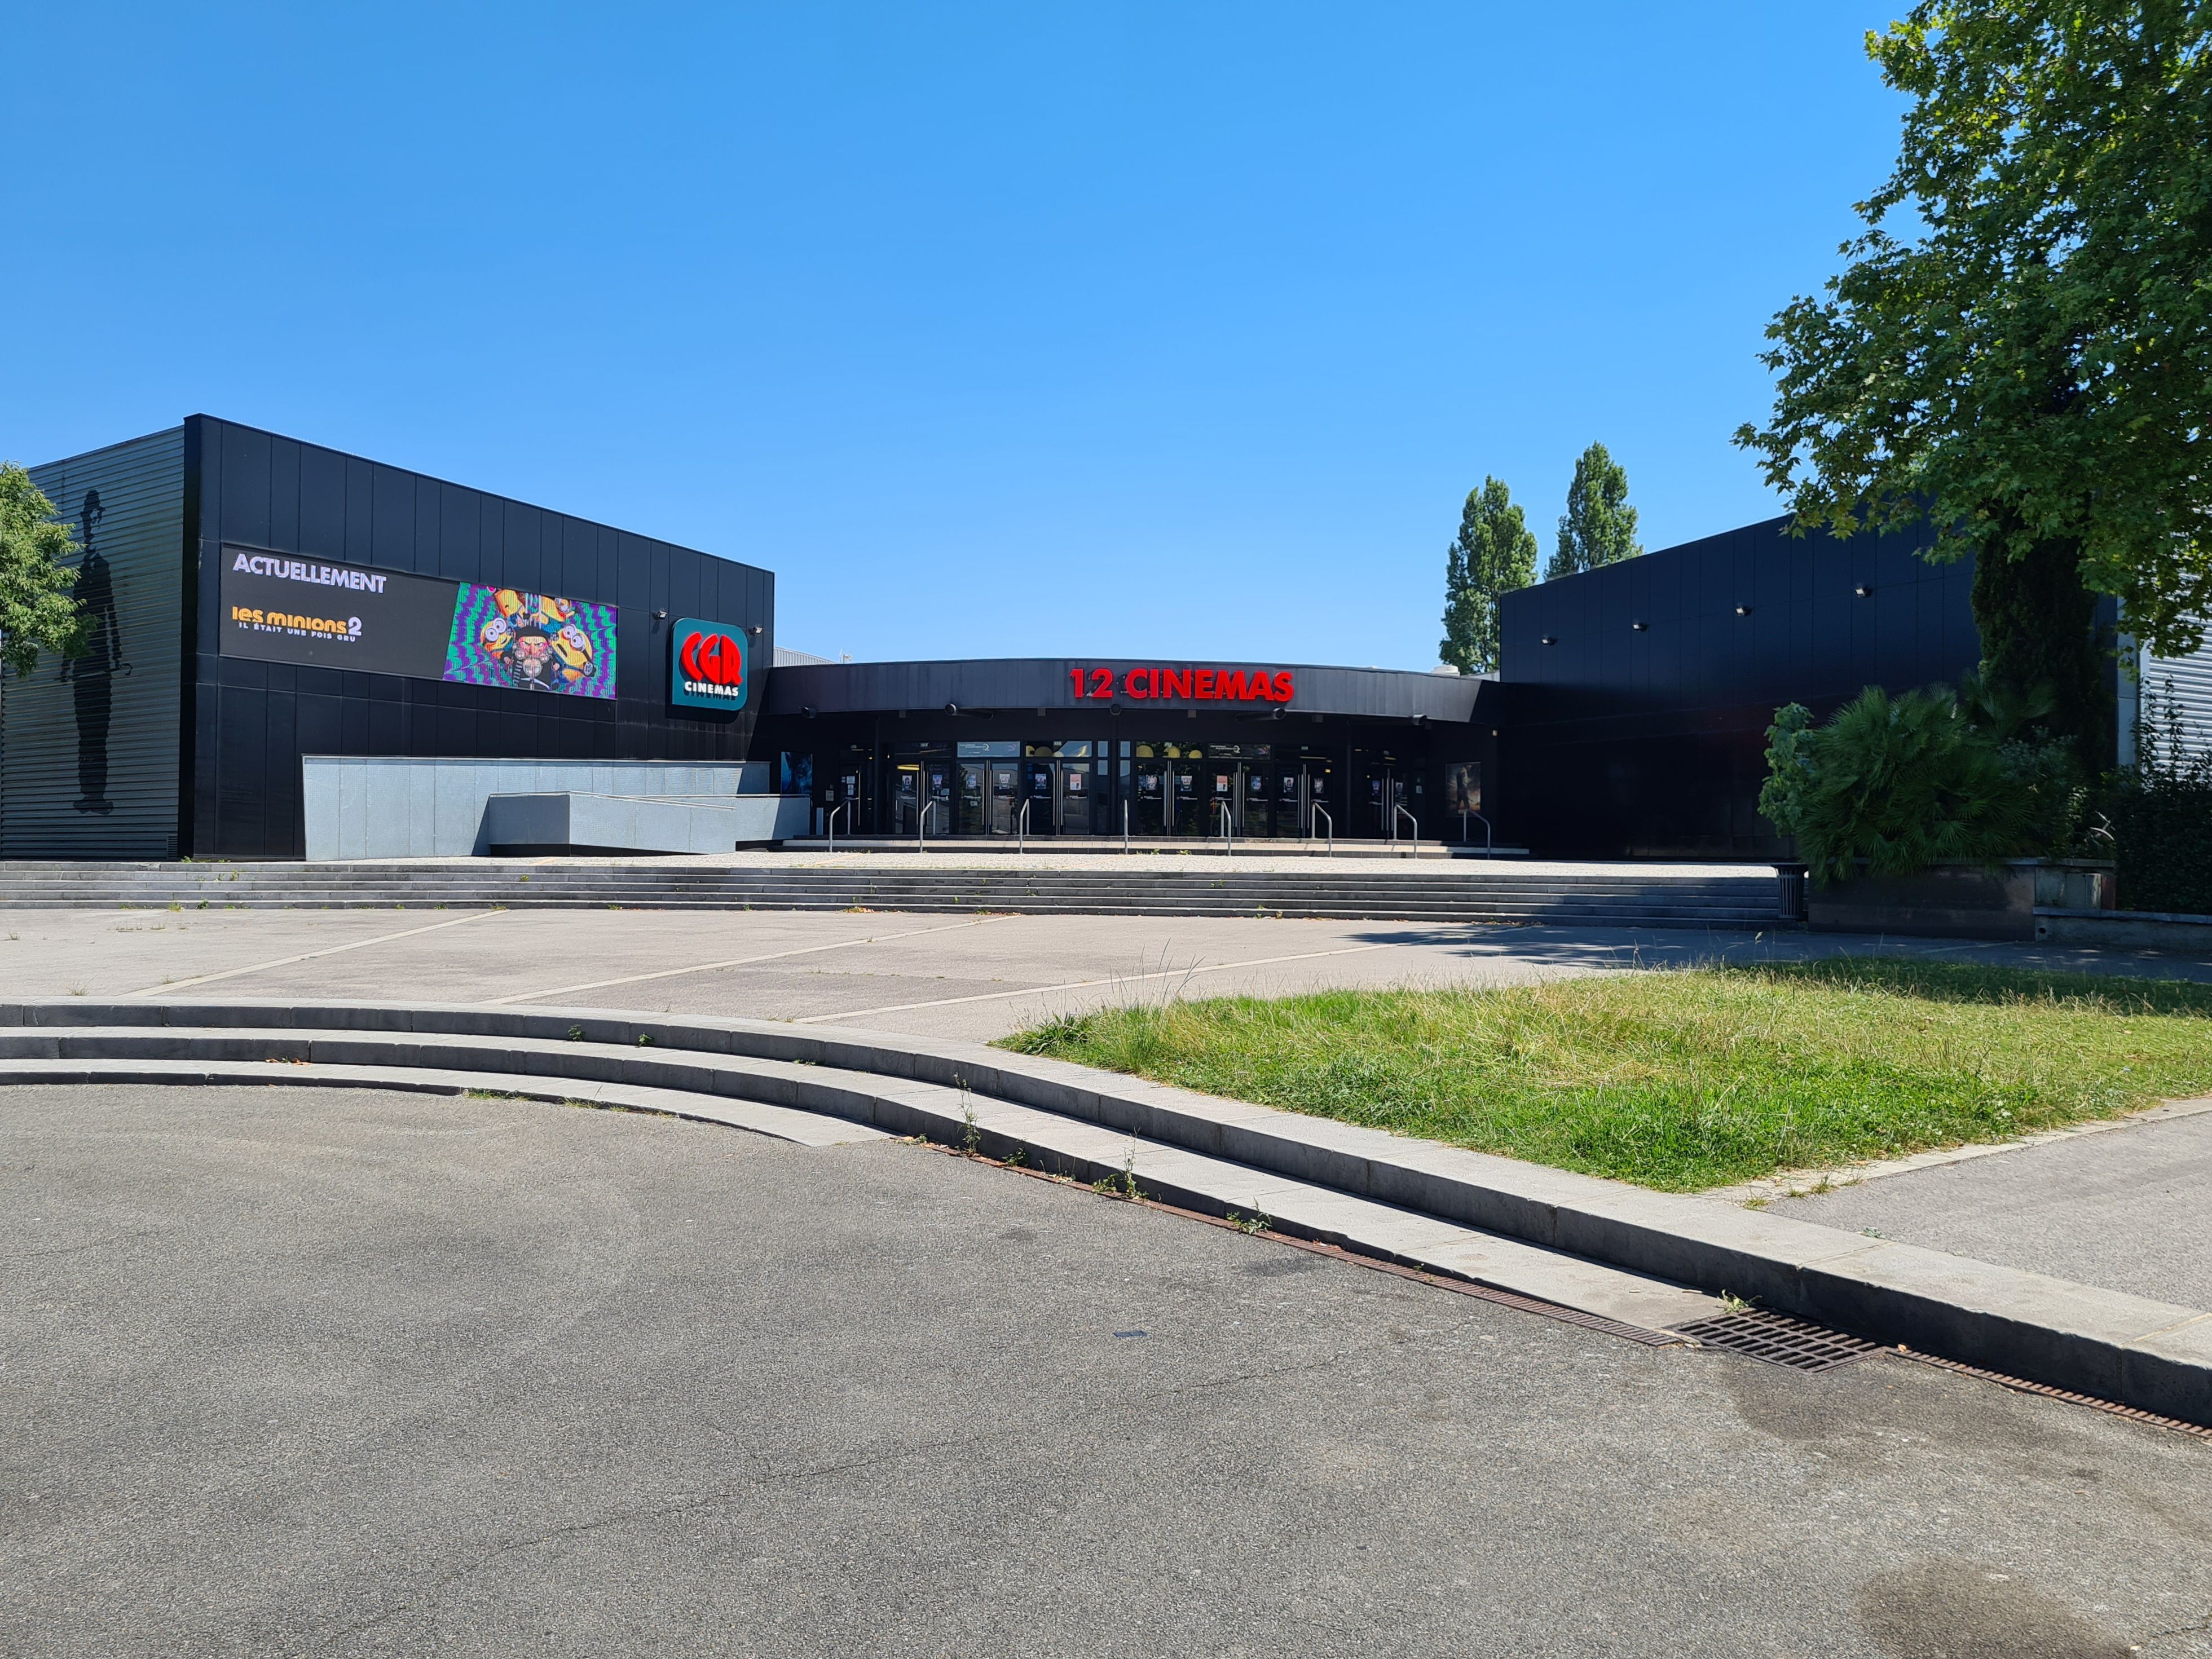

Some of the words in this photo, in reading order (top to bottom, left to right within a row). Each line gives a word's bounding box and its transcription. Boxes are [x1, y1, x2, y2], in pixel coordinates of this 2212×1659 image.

[232, 553, 387, 594] ACTUELLEMENT
[253, 623, 282, 634] ÉTAIT
[287, 627, 306, 637] UNE
[311, 630, 333, 640] FOIS
[337, 634, 356, 643] GRU
[684, 681, 739, 697] CINEMAS
[1069, 668, 1113, 698] 12
[1125, 668, 1295, 702] CINEMAS
